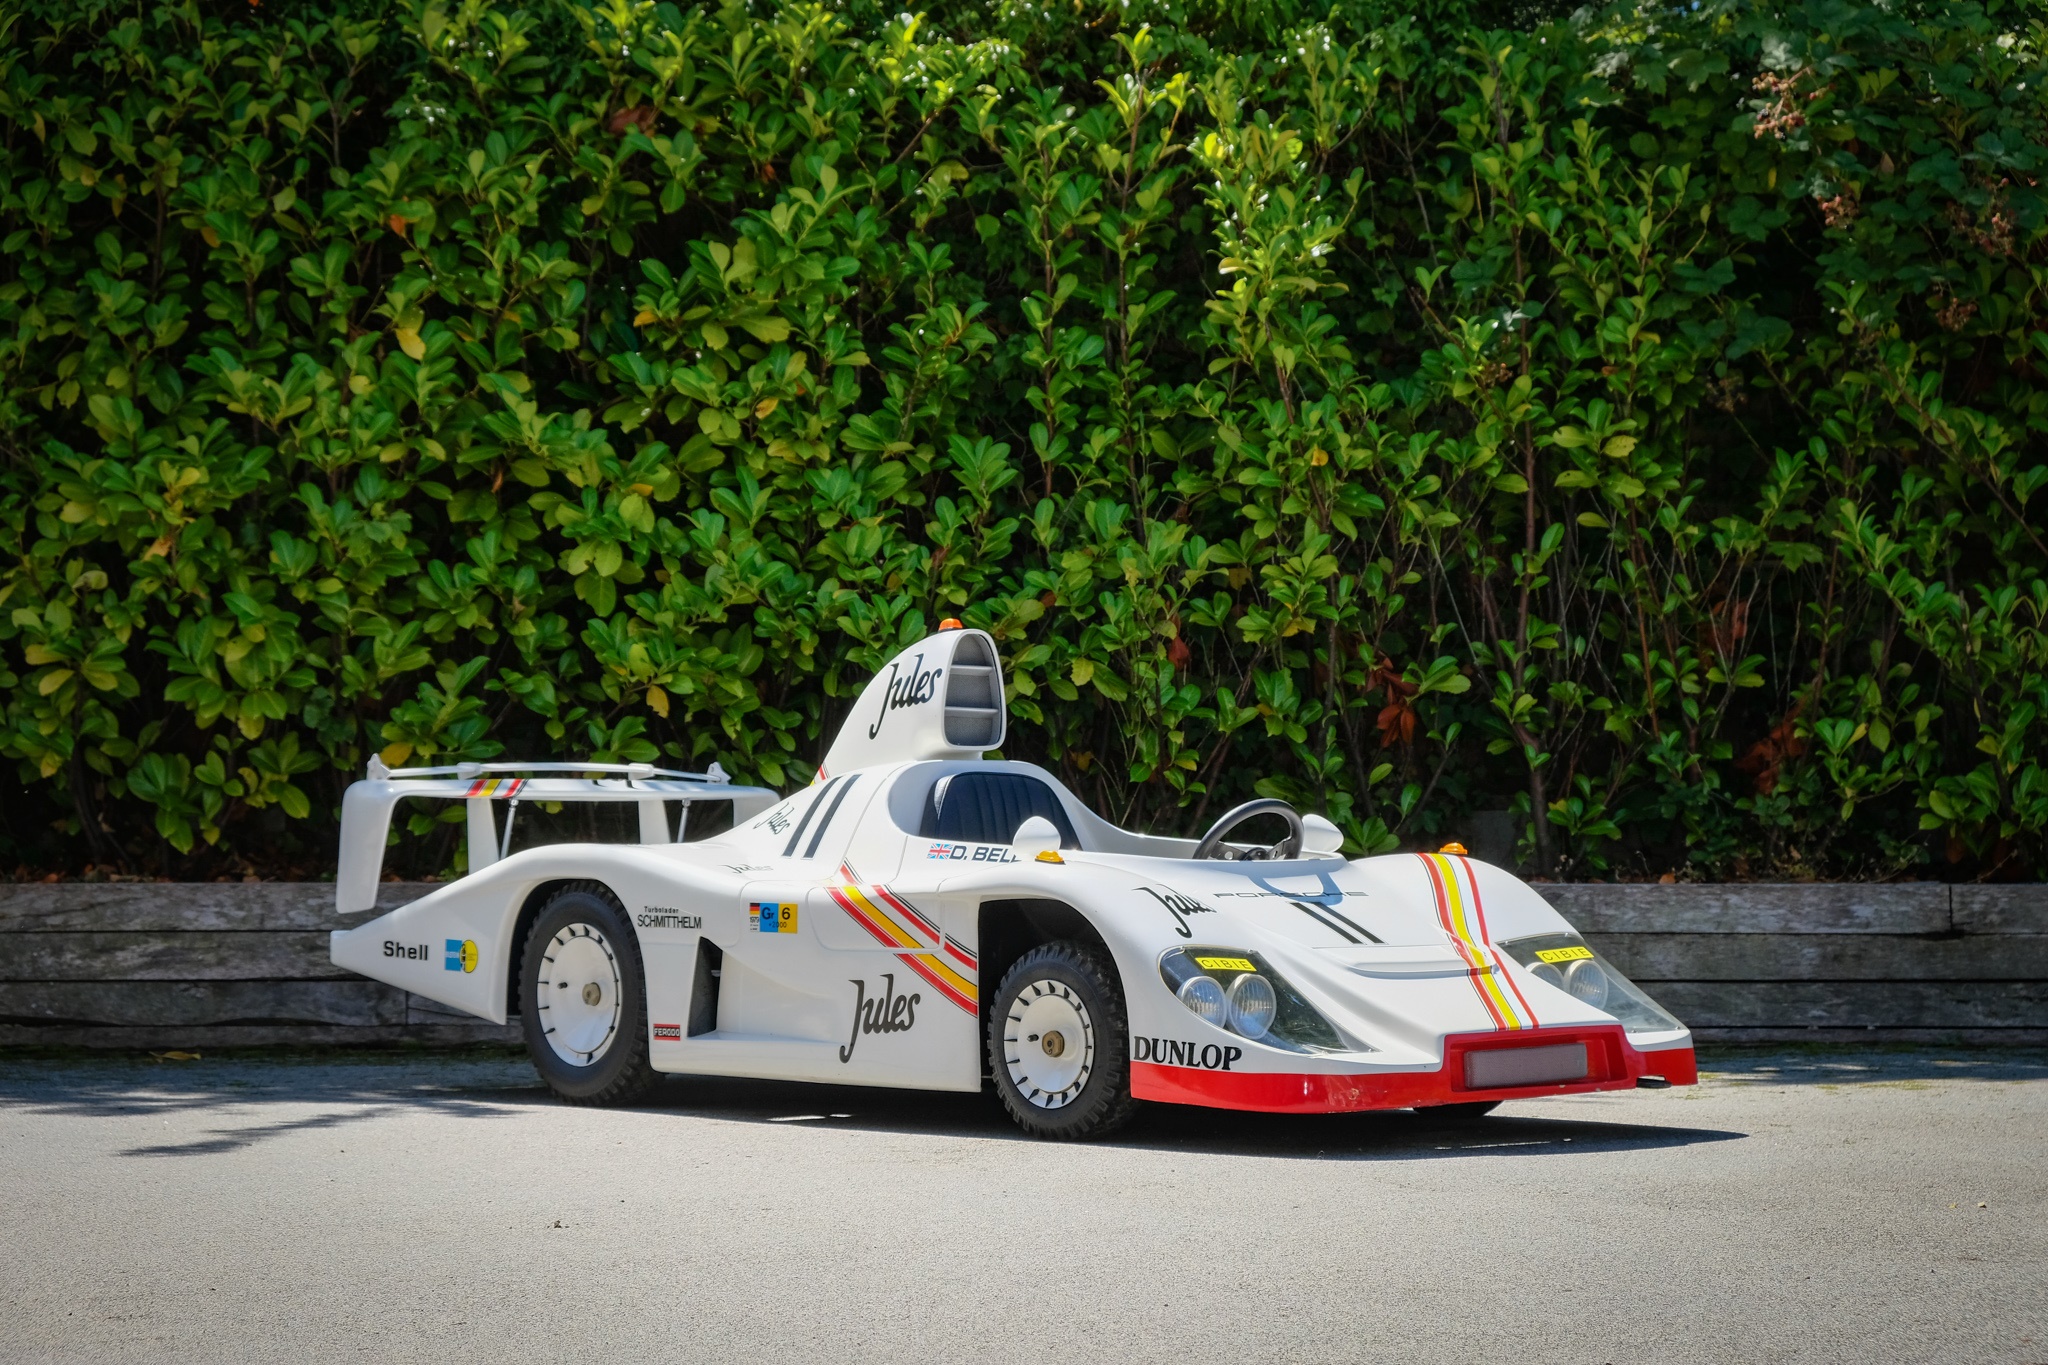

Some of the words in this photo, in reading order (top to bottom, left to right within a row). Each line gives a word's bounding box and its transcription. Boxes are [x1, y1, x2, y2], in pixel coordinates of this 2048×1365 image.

[868, 653, 943, 740] Jules
[752, 802, 795, 835] Jules
[949, 845, 968, 861] D.
[643, 905, 679, 914] Turbolader
[761, 906, 775, 920] Gr
[781, 906, 791, 920] 6
[1131, 883, 1218, 939] Jul
[637, 914, 702, 930] SCHMITTHELM
[383, 940, 429, 961] Shell
[1540, 947, 1591, 962] CIBIE
[1200, 958, 1252, 970] CIBIE
[838, 973, 922, 1064] Jules
[1133, 1035, 1243, 1071] DUNLOP
